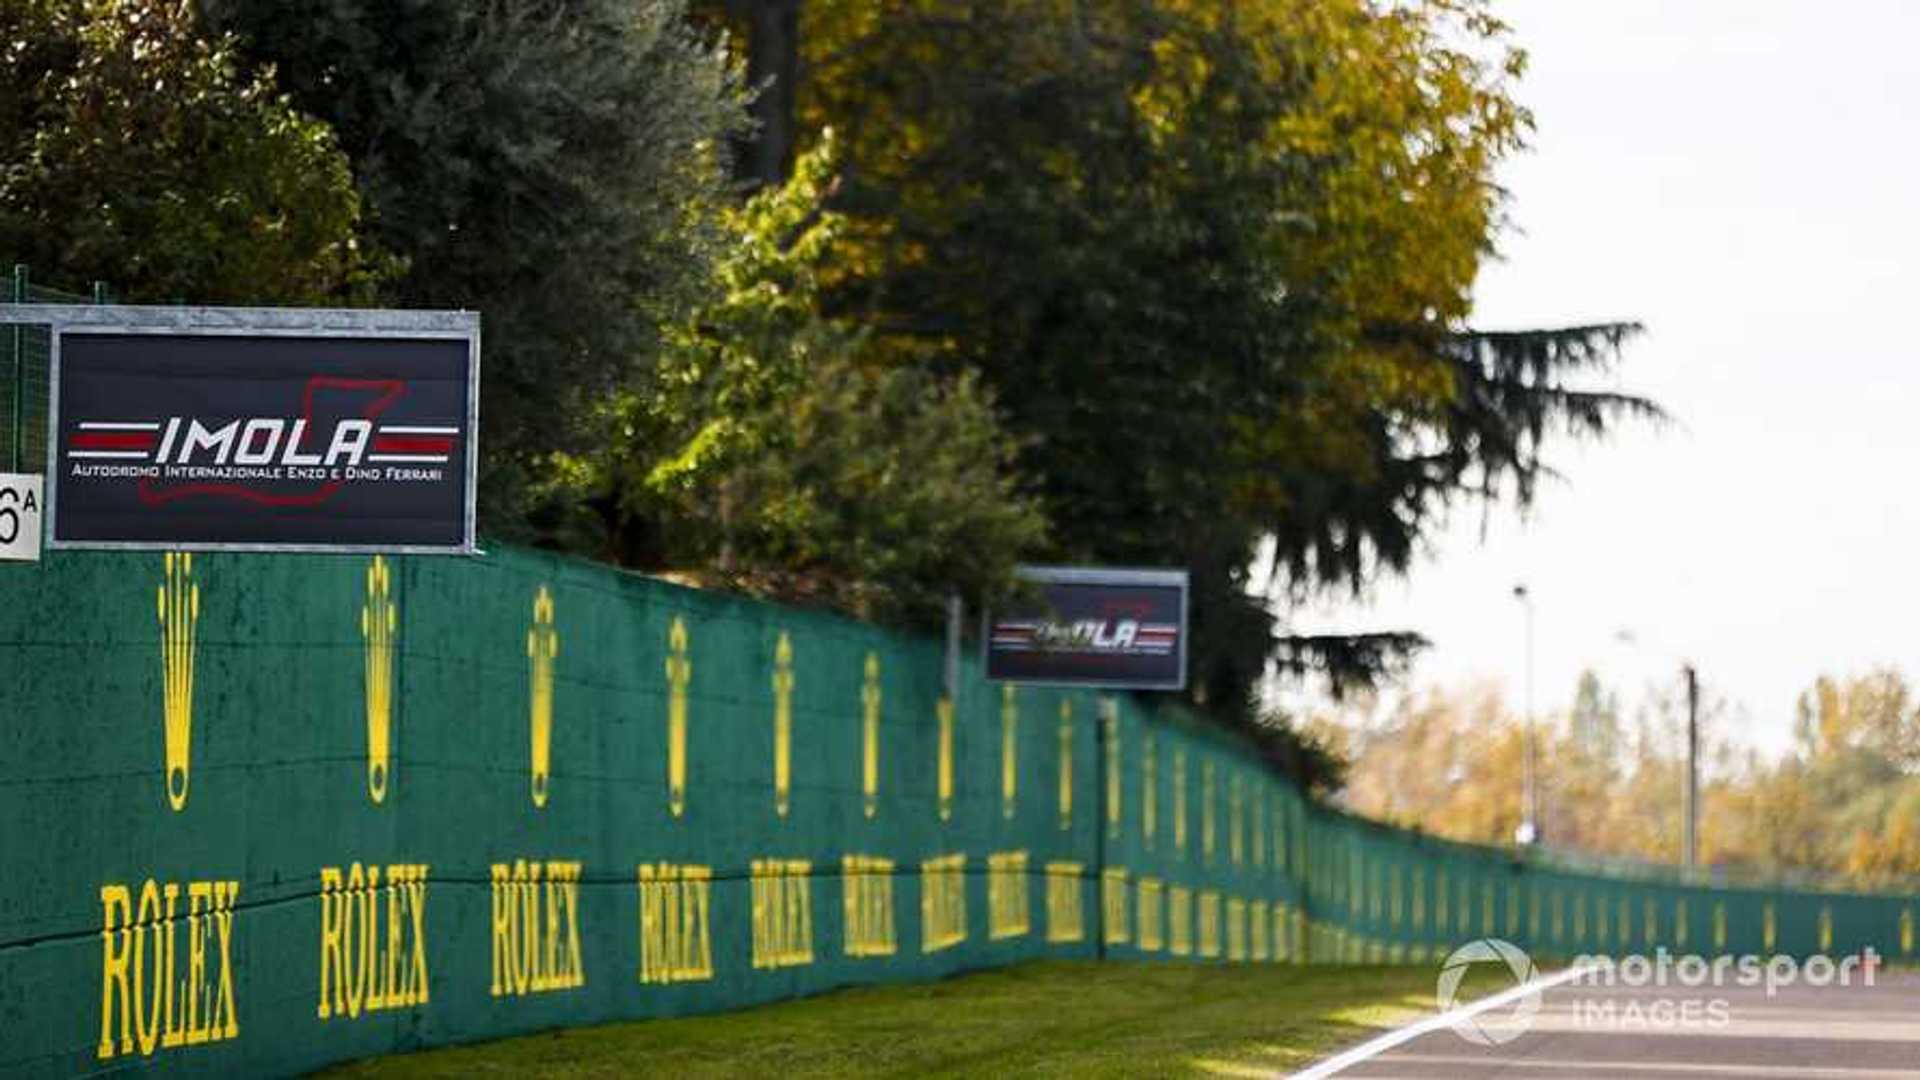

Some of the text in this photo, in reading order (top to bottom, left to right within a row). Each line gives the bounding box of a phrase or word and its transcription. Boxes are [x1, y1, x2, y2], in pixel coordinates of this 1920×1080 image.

[155, 417, 372, 466] IMOLA
[287, 466, 326, 479] ENZO
[345, 467, 380, 480] DINO
[386, 467, 442, 481] FERRARI
[98, 879, 239, 1058] ROLEX
[318, 862, 429, 1019] ROLEX
[491, 860, 584, 996] ROLEX
